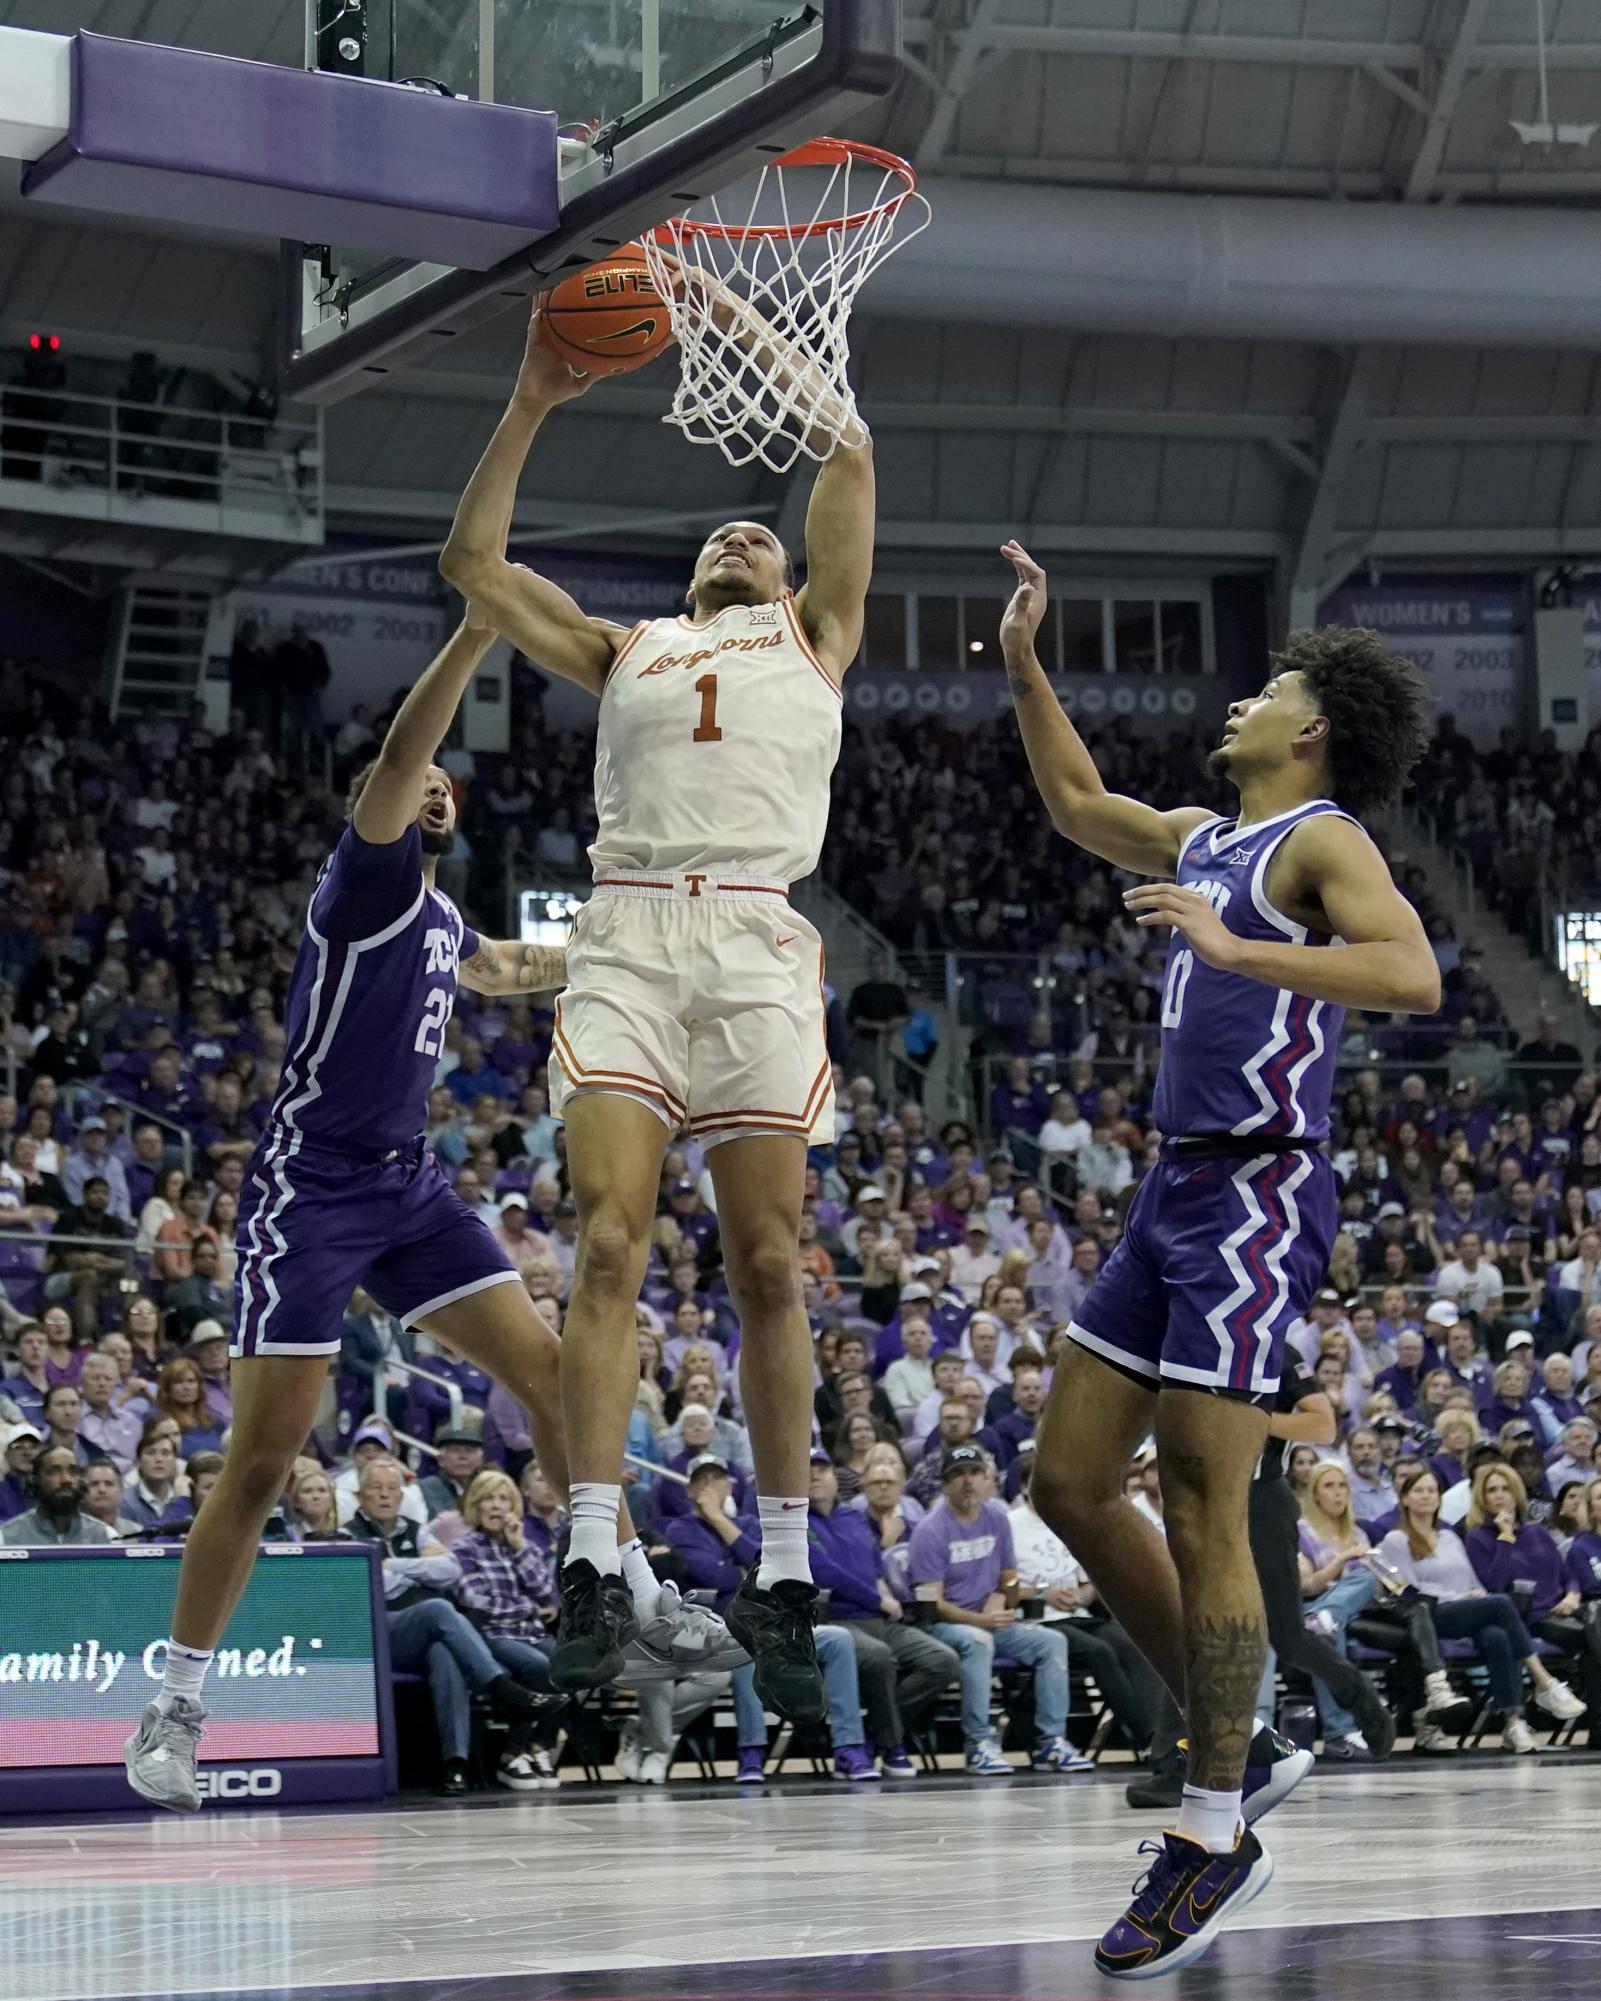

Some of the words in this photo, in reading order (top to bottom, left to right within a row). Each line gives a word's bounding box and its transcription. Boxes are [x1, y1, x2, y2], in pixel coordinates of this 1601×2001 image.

[584, 273, 655, 299] ELITE
[1351, 601, 1471, 626] WOMEN'S
[693, 674, 723, 742] 1
[684, 874, 707, 897] T
[142, 1635, 308, 1680] Oned.
[194, 1768, 282, 1799] EICO
